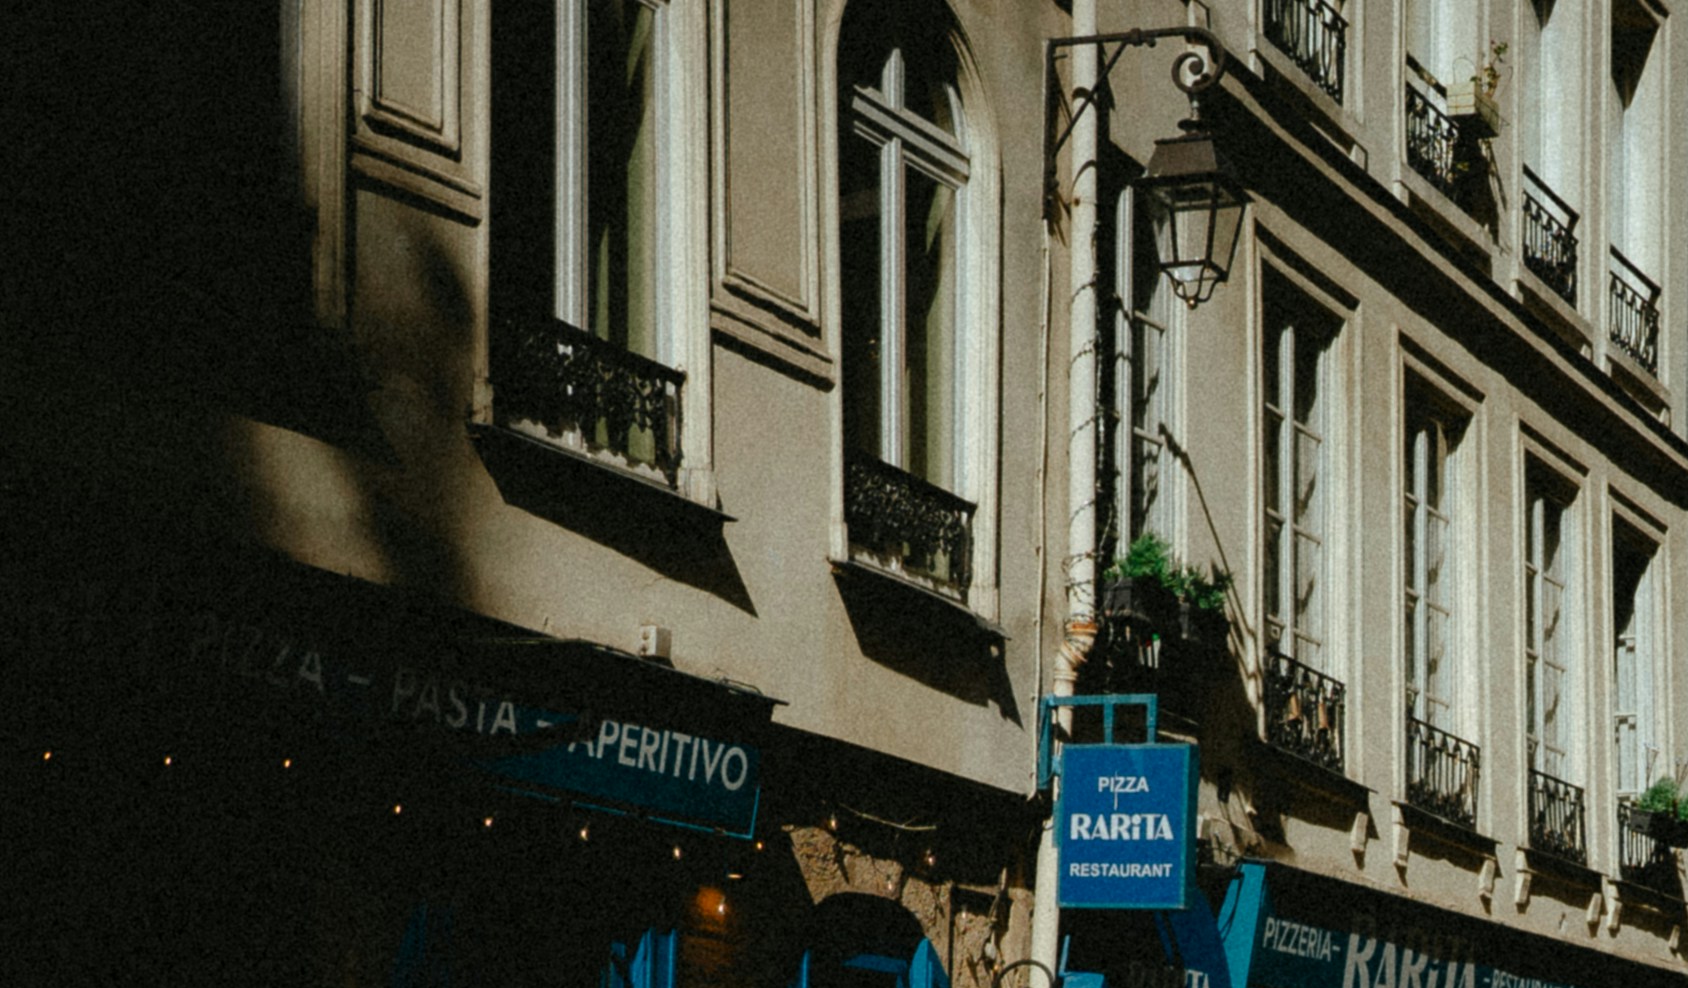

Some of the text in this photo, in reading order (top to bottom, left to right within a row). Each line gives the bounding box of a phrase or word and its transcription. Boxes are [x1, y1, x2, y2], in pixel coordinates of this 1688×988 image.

[391, 668, 518, 735] PASTA
[567, 708, 748, 791] APERITIVO
[1098, 776, 1149, 793] PIZZA
[1069, 863, 1173, 879] RESTAURANT
